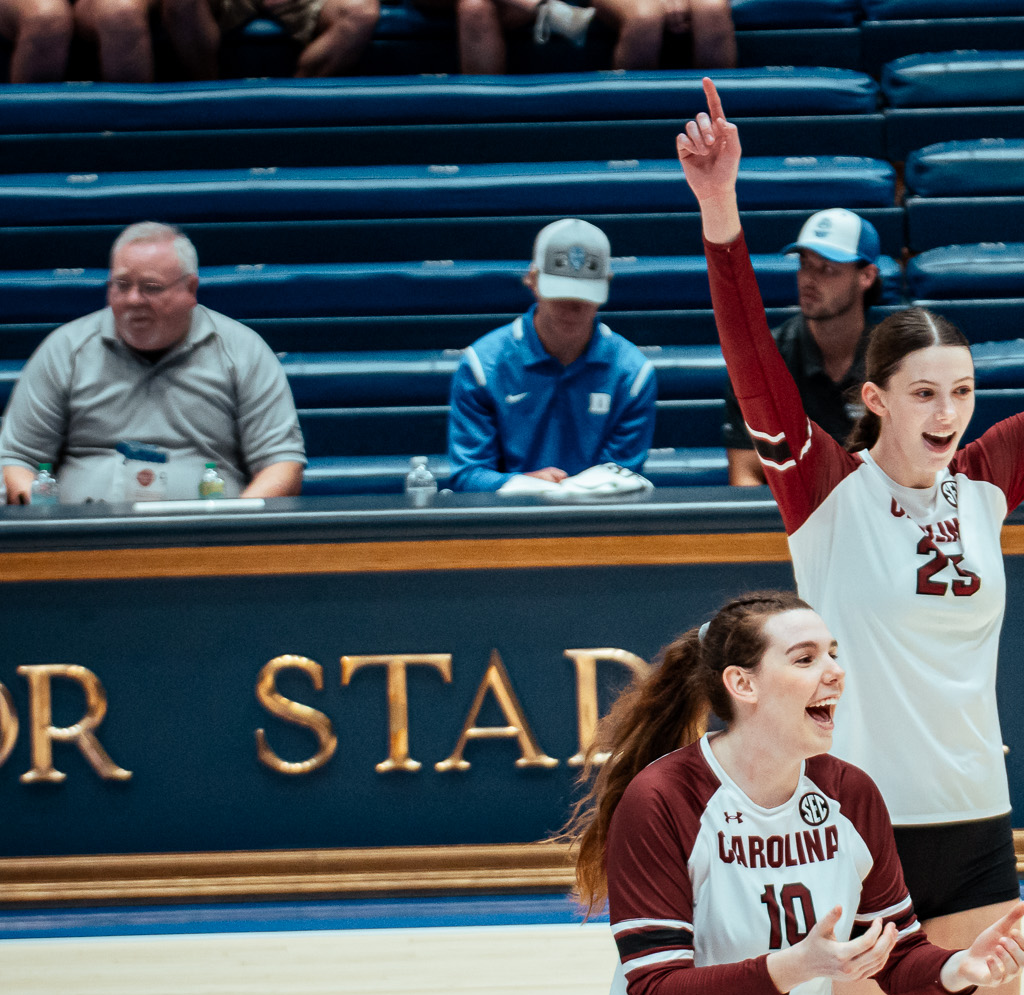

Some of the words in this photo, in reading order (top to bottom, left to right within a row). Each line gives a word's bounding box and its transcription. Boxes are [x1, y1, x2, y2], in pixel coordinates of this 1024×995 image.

[916, 535, 981, 596] 25
[0, 663, 133, 784] R
[800, 793, 830, 824] SEC
[718, 825, 838, 868] CAROLINA
[760, 882, 817, 950] 10
